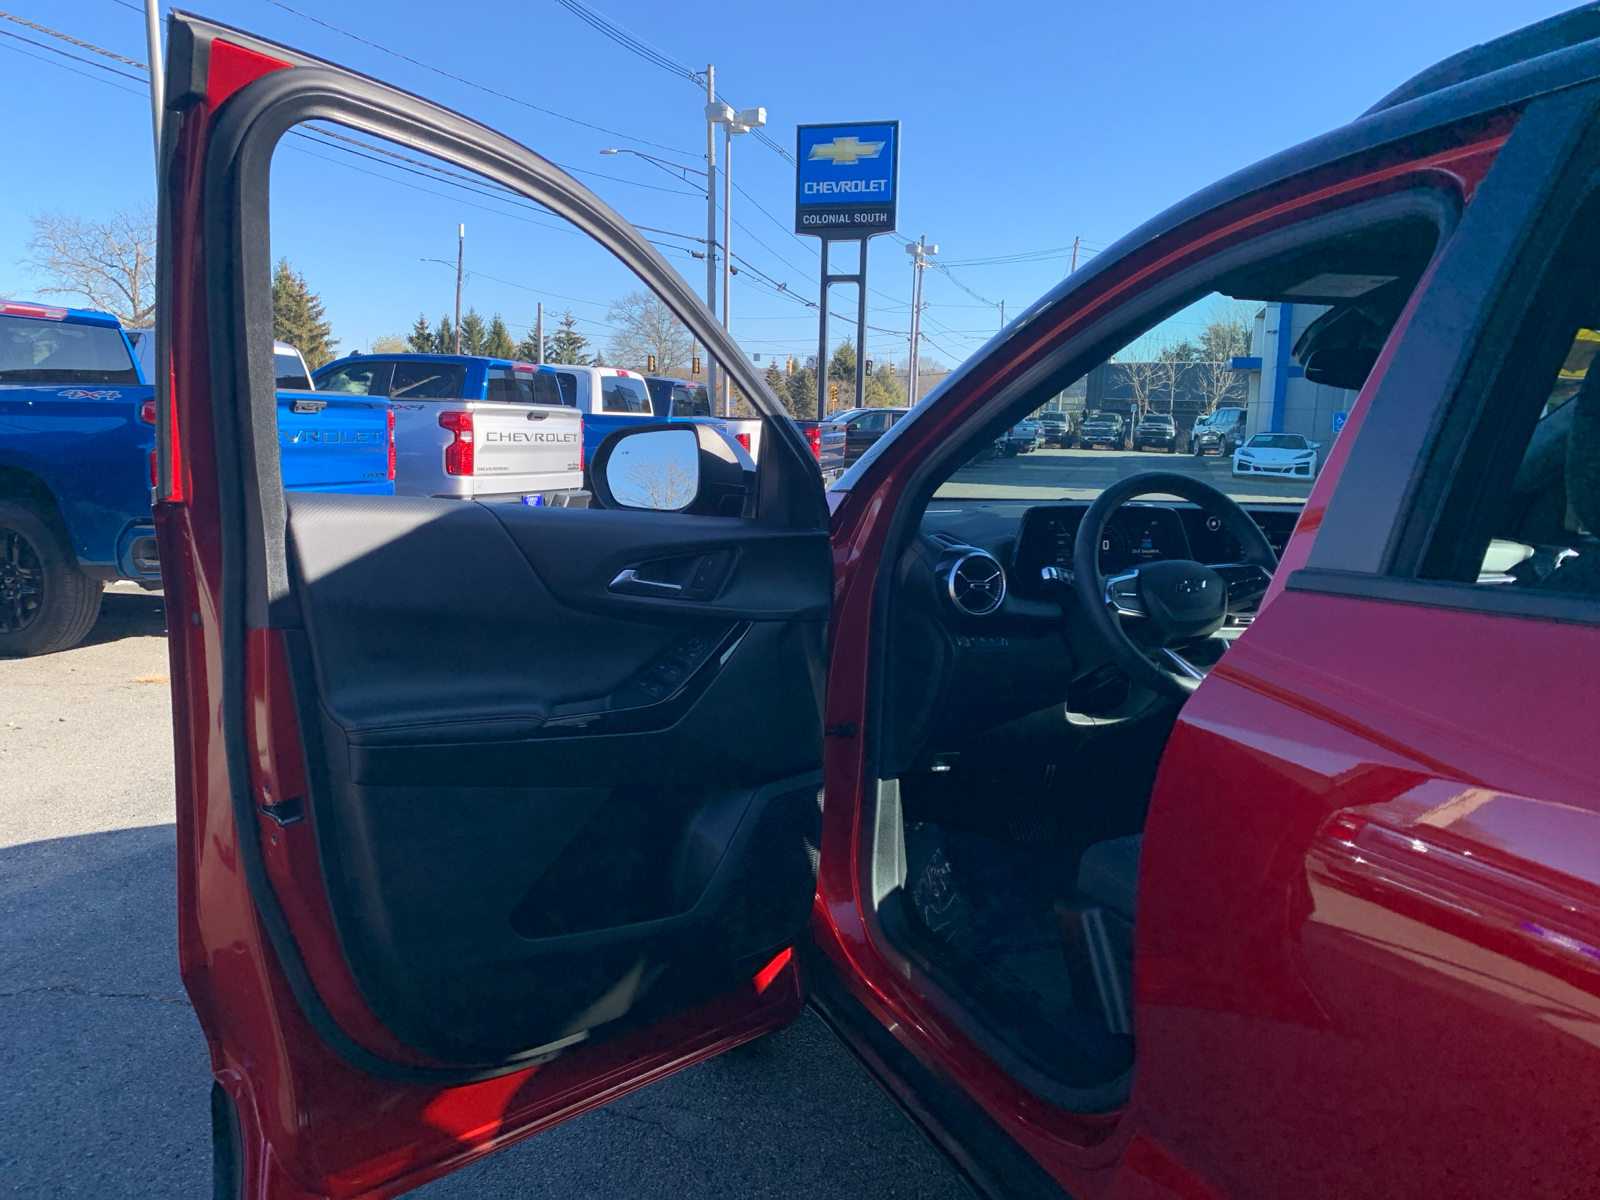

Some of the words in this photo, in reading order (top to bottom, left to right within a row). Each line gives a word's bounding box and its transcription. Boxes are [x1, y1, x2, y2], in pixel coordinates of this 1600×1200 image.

[804, 179, 888, 194] CHEVROLET
[803, 213, 851, 224] COLONIAL
[854, 212, 887, 223] SOUTH
[486, 432, 578, 443] CHEVROLET
